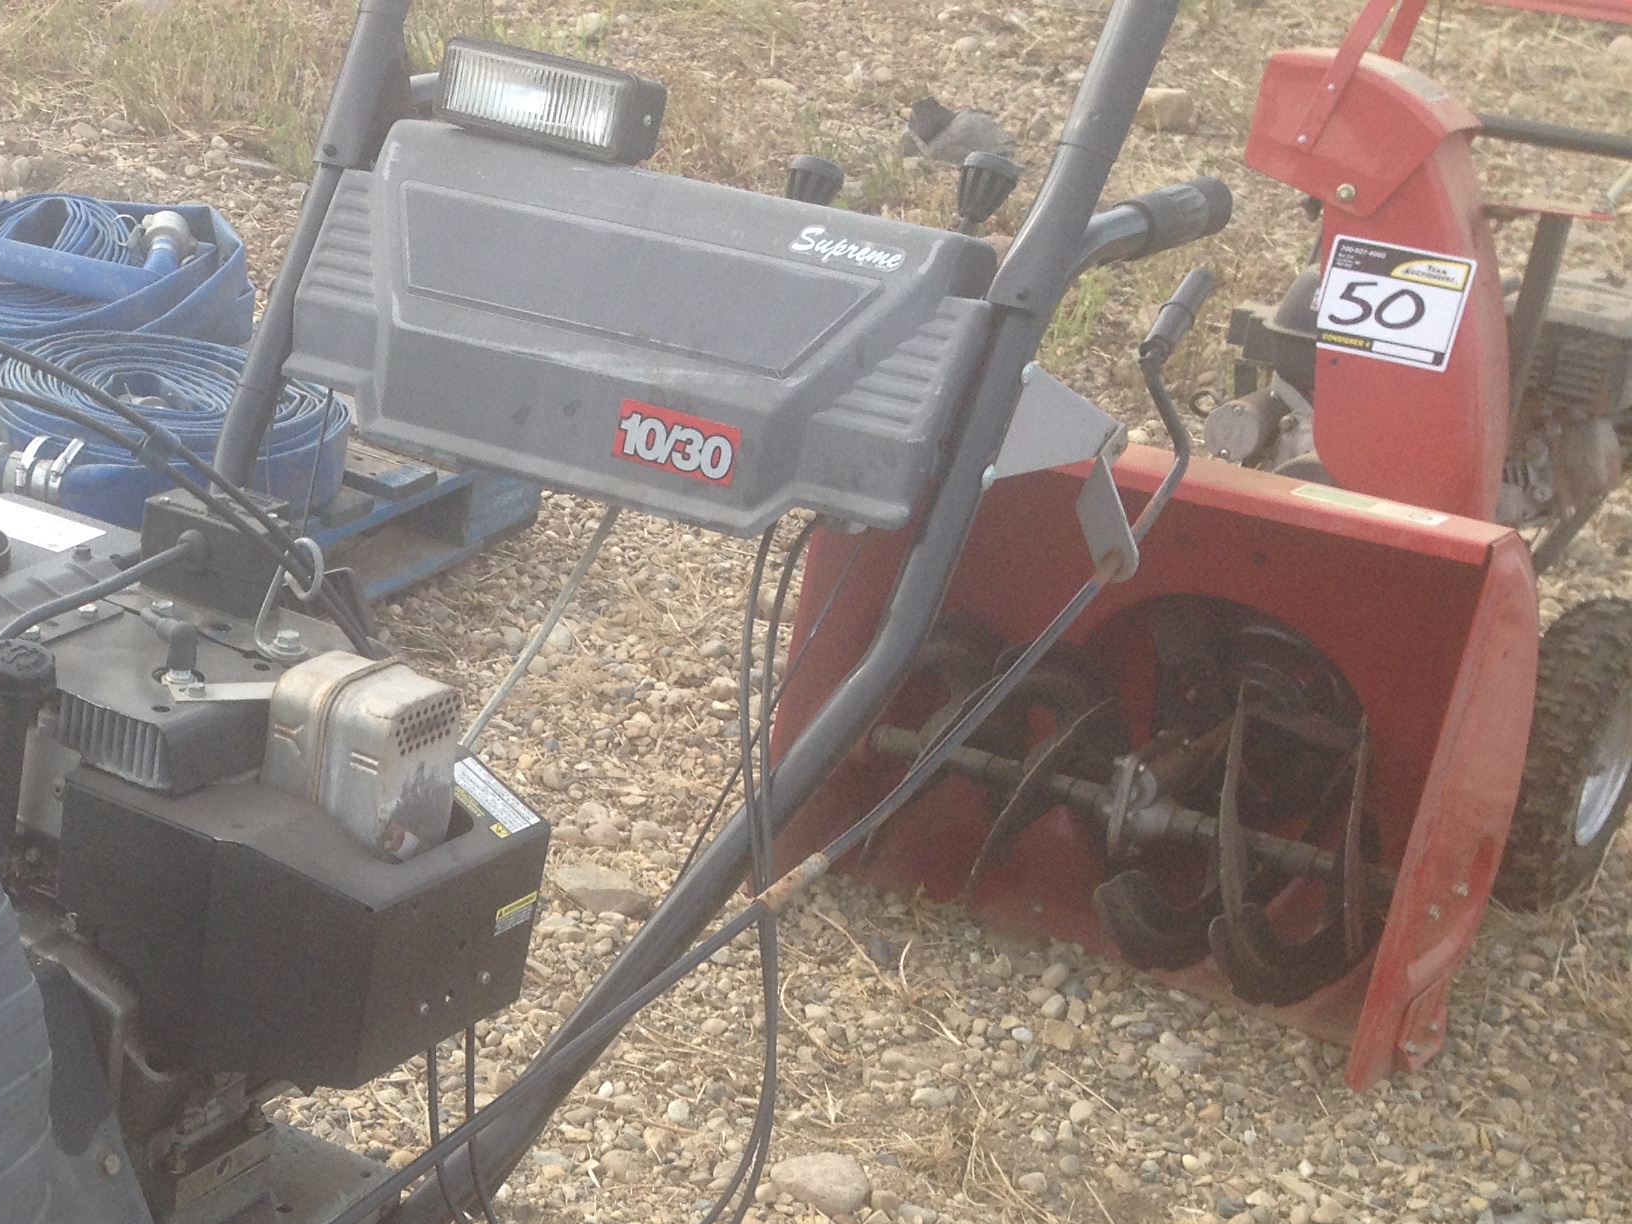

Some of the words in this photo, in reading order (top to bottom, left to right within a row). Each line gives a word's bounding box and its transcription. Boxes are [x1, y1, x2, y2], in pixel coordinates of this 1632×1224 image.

[791, 226, 903, 268] Supreme
[1328, 281, 1425, 330] 50
[620, 413, 733, 480] 10/30
